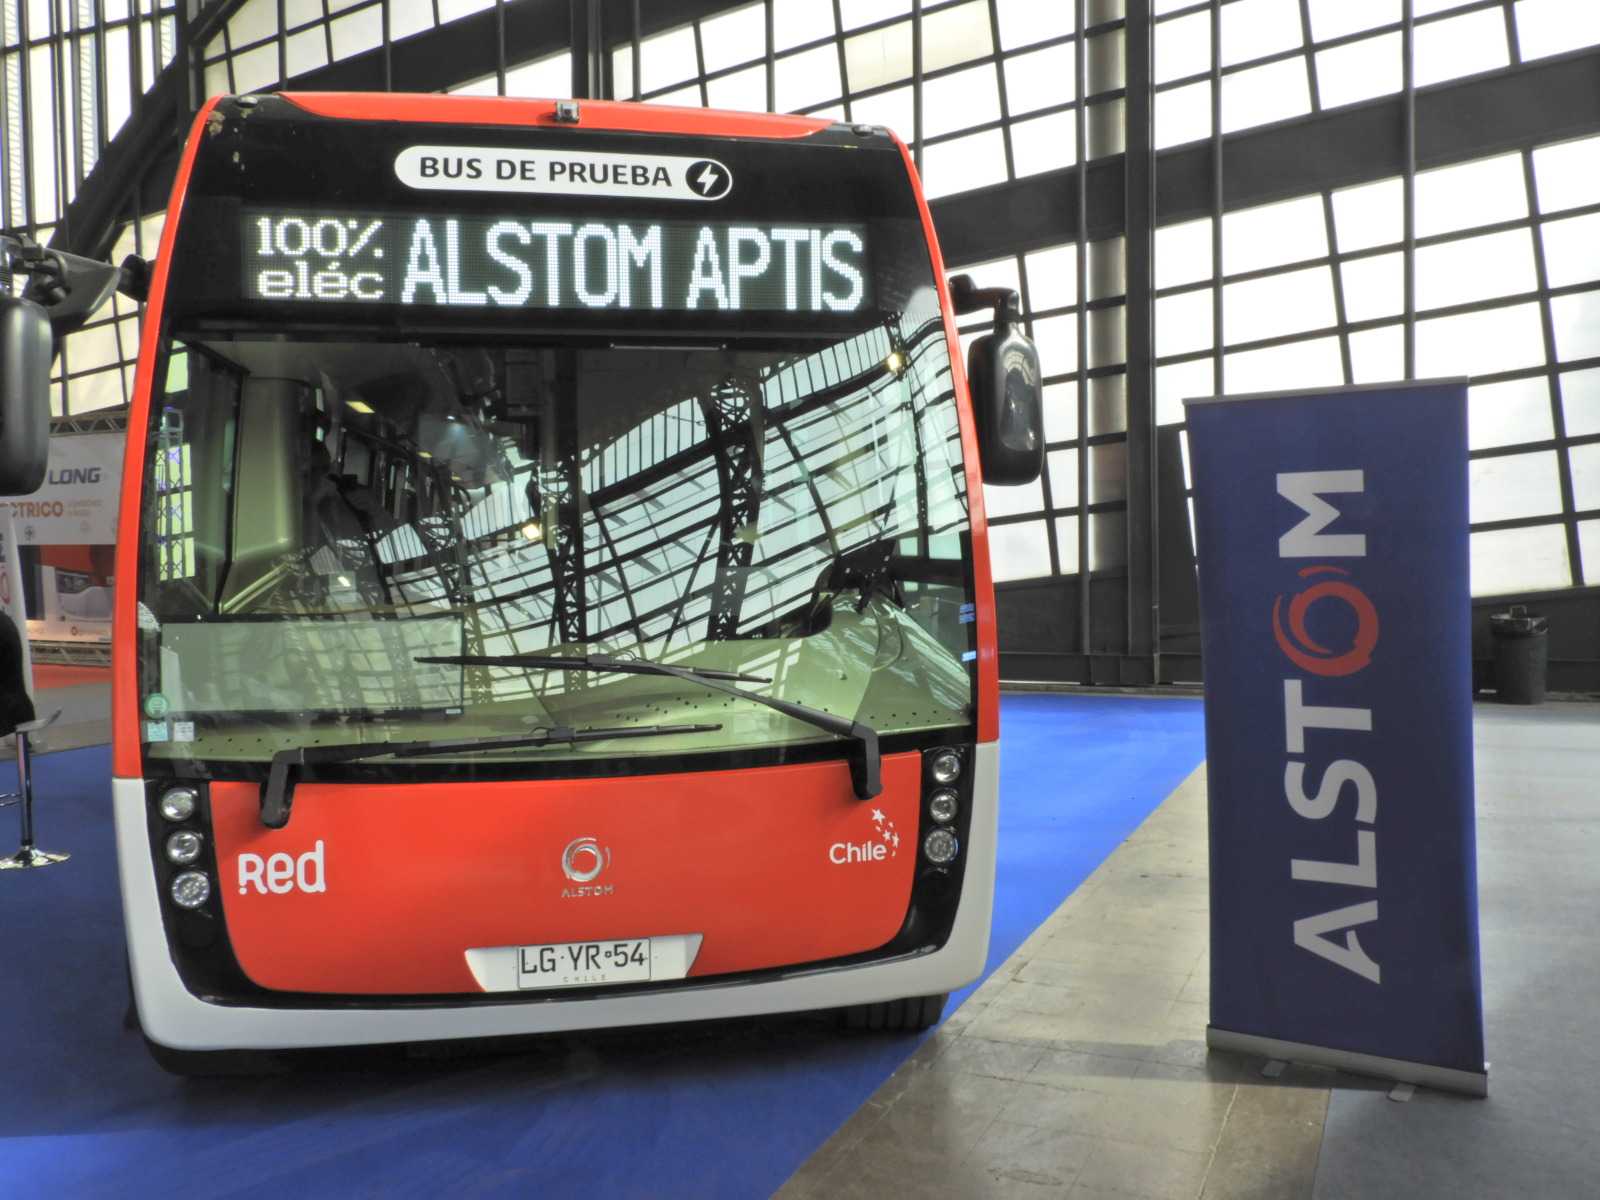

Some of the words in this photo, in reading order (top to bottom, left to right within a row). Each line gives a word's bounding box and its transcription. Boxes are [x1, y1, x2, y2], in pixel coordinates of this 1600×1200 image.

[419, 157, 482, 179] BUS
[496, 160, 536, 181] DE
[549, 162, 672, 187] PRUEBA
[257, 262, 385, 301] eléc
[401, 218, 662, 307] ALSTOM
[686, 225, 864, 311] APTIS
[48, 467, 101, 485] LONG
[1273, 469, 1381, 984] ALSTOM
[237, 839, 326, 895] Red
[829, 840, 887, 865] Chile
[561, 885, 614, 897] ALSTOM
